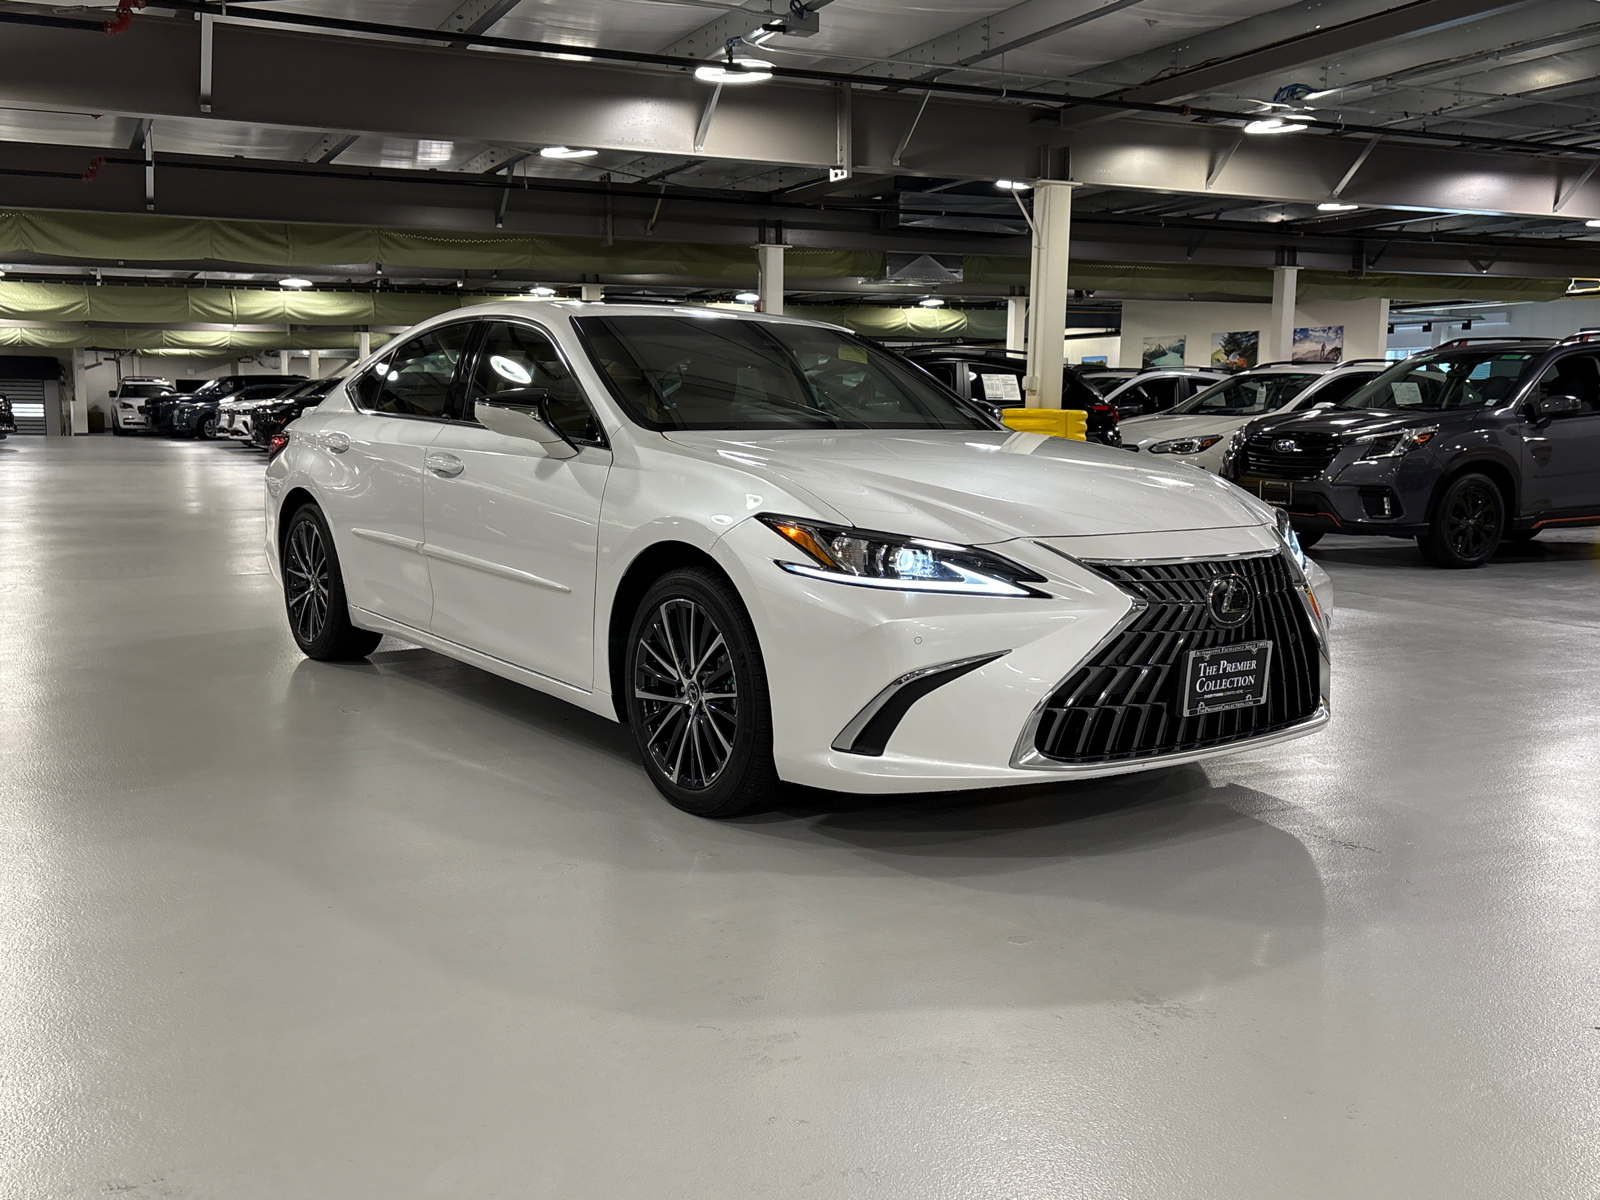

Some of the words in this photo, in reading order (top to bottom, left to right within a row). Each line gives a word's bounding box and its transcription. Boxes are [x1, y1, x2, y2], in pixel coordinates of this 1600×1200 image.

[1198, 662, 1218, 677] THE
[1219, 660, 1257, 674] PREMIER
[1196, 675, 1256, 693] COLLECTION
